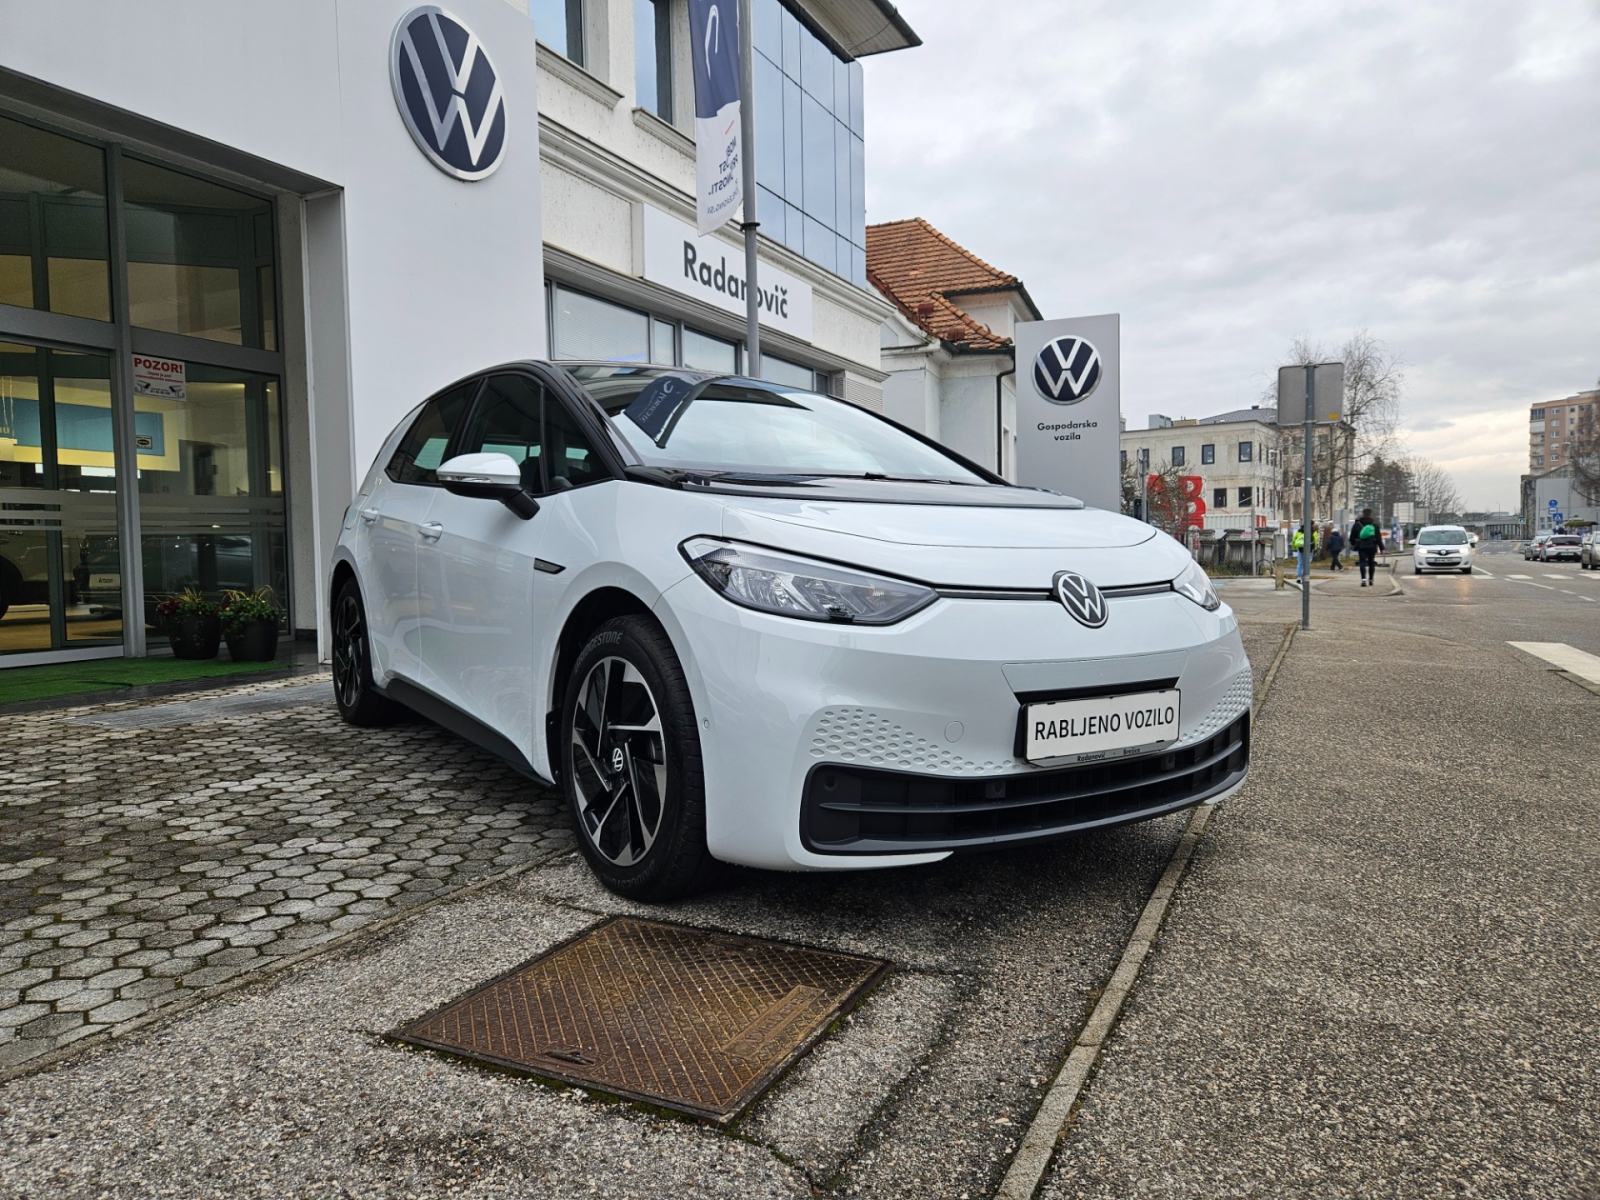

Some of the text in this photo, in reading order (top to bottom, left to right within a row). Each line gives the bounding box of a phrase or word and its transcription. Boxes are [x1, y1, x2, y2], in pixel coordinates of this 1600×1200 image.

[134, 357, 183, 374] POZOR!
[1037, 420, 1098, 432] Gospodarska
[1054, 433, 1081, 441] vozila
[1034, 706, 1175, 741] RABLJENO VOZILO
